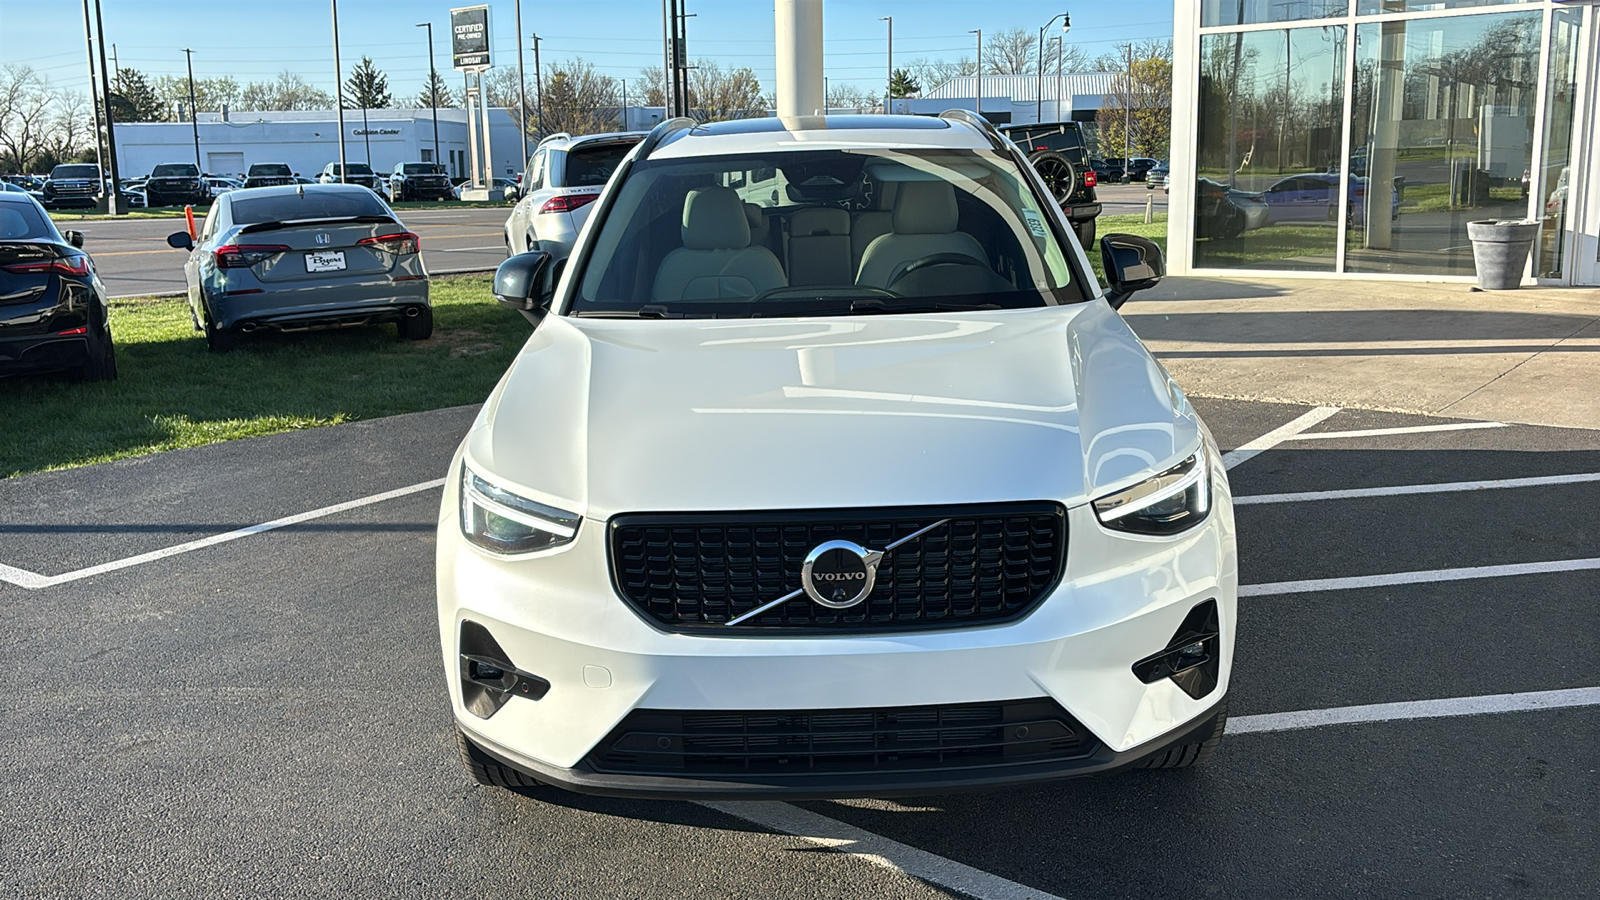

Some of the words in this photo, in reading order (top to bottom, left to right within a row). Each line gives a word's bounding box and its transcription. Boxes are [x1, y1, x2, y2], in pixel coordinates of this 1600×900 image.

[455, 23, 484, 33] CERTIFIED
[460, 57, 482, 65] LINDSAY
[812, 571, 866, 581] VOLVO
